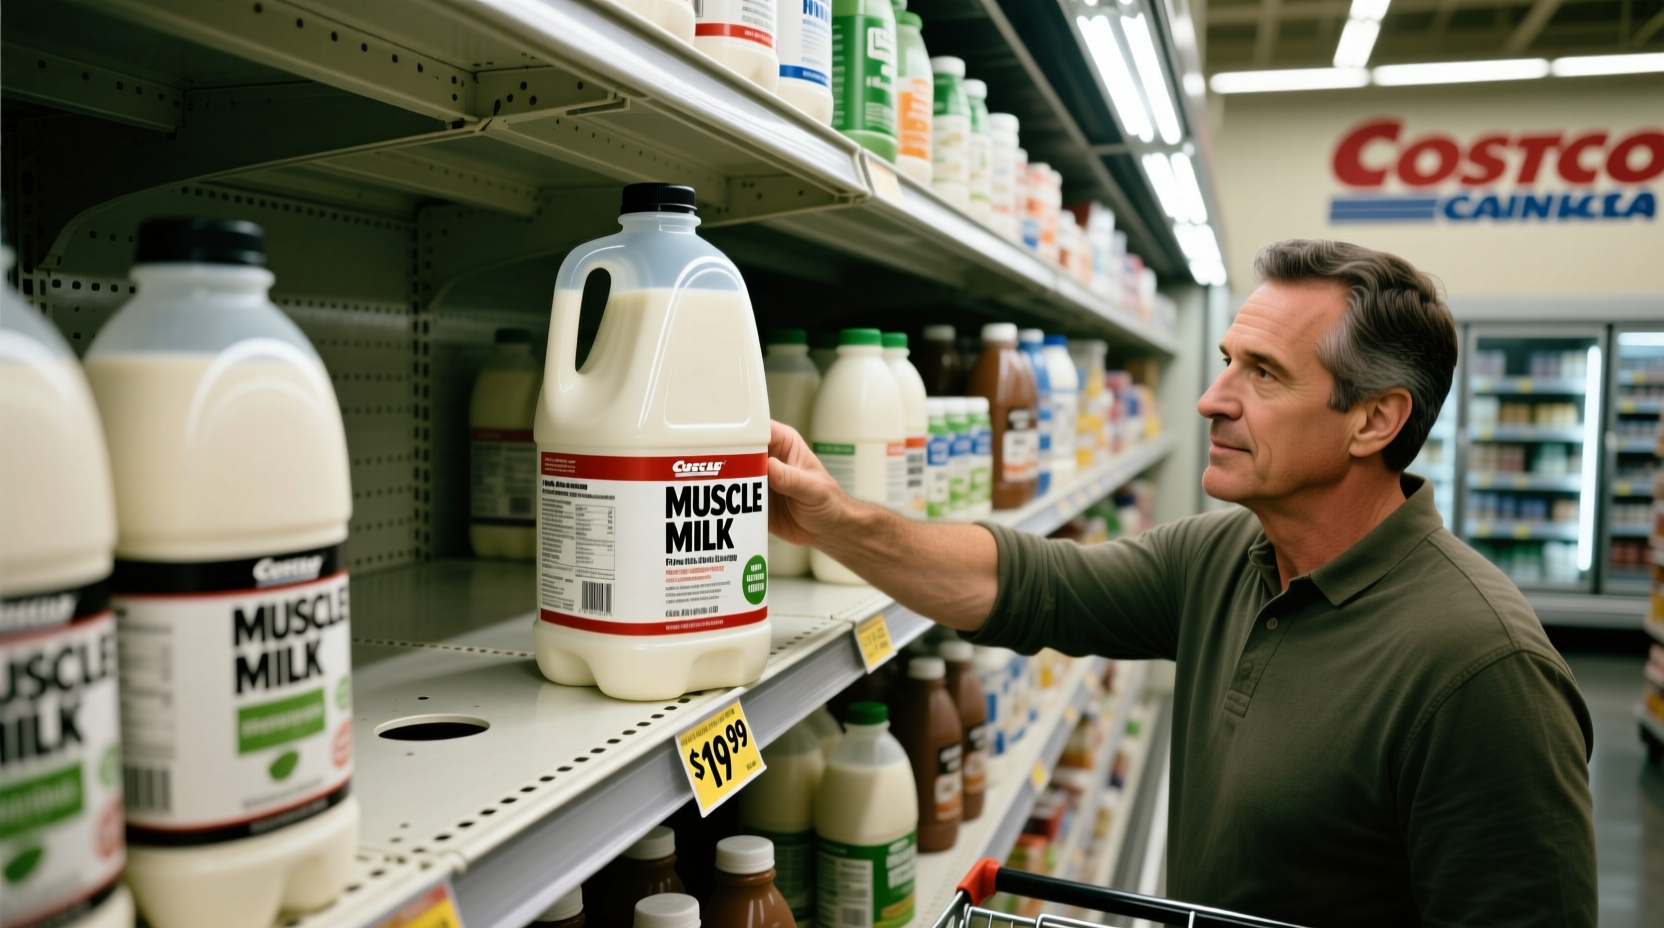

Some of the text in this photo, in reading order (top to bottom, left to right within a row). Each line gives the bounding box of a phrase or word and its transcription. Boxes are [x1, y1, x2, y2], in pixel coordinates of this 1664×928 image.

[1332, 121, 1664, 187] COSTCO
[665, 481, 763, 519] MUSCLE
[665, 518, 735, 554] MILK
[234, 587, 347, 647] MUSCLE
[0, 634, 114, 703] USCLE
[236, 638, 323, 694] MILK
[0, 702, 83, 764] ILK
